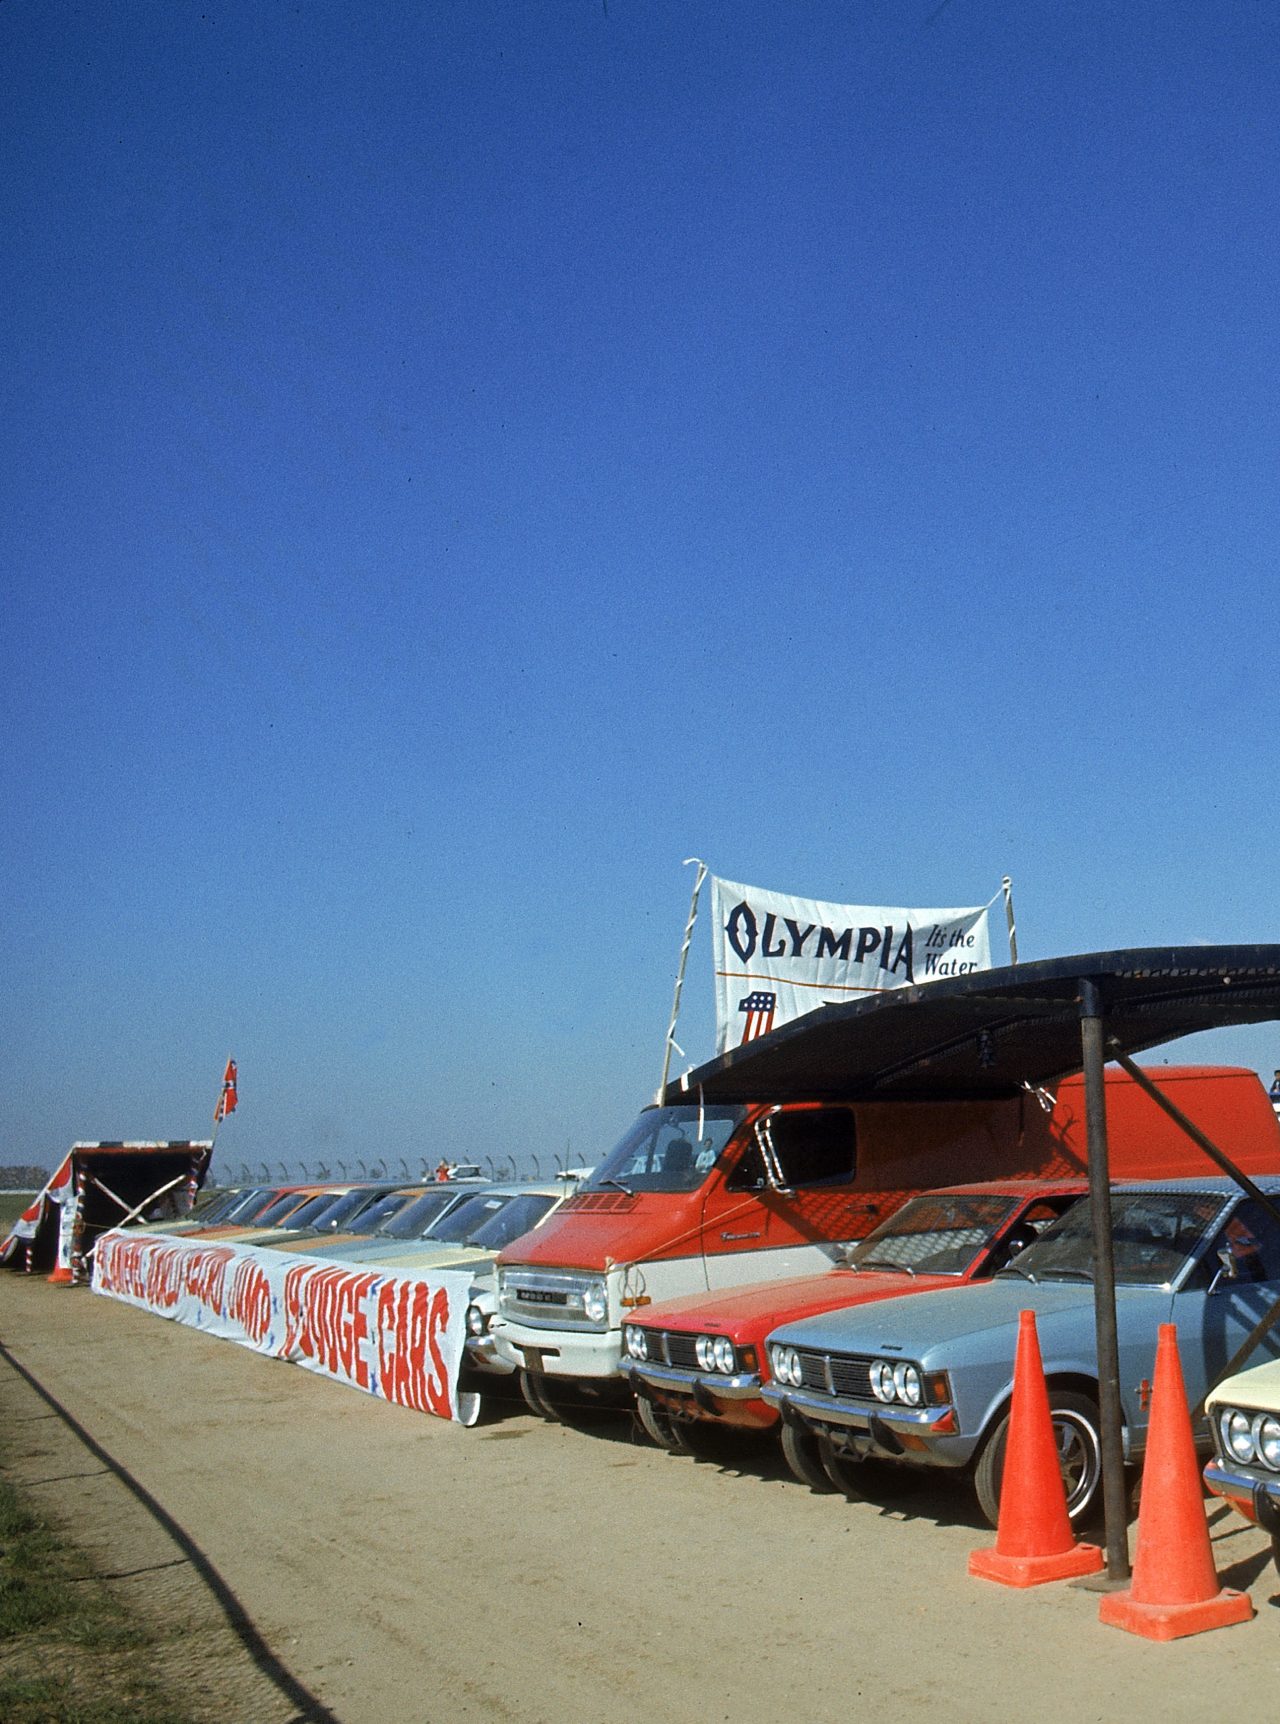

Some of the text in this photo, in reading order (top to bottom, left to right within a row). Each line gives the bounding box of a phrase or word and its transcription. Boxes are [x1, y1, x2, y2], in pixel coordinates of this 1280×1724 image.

[725, 901, 914, 984] OLYMPIA
[924, 924, 975, 948] It's the
[924, 953, 978, 977] Water
[299, 1266, 384, 1389] DODGE
[377, 1278, 452, 1419] CARS
